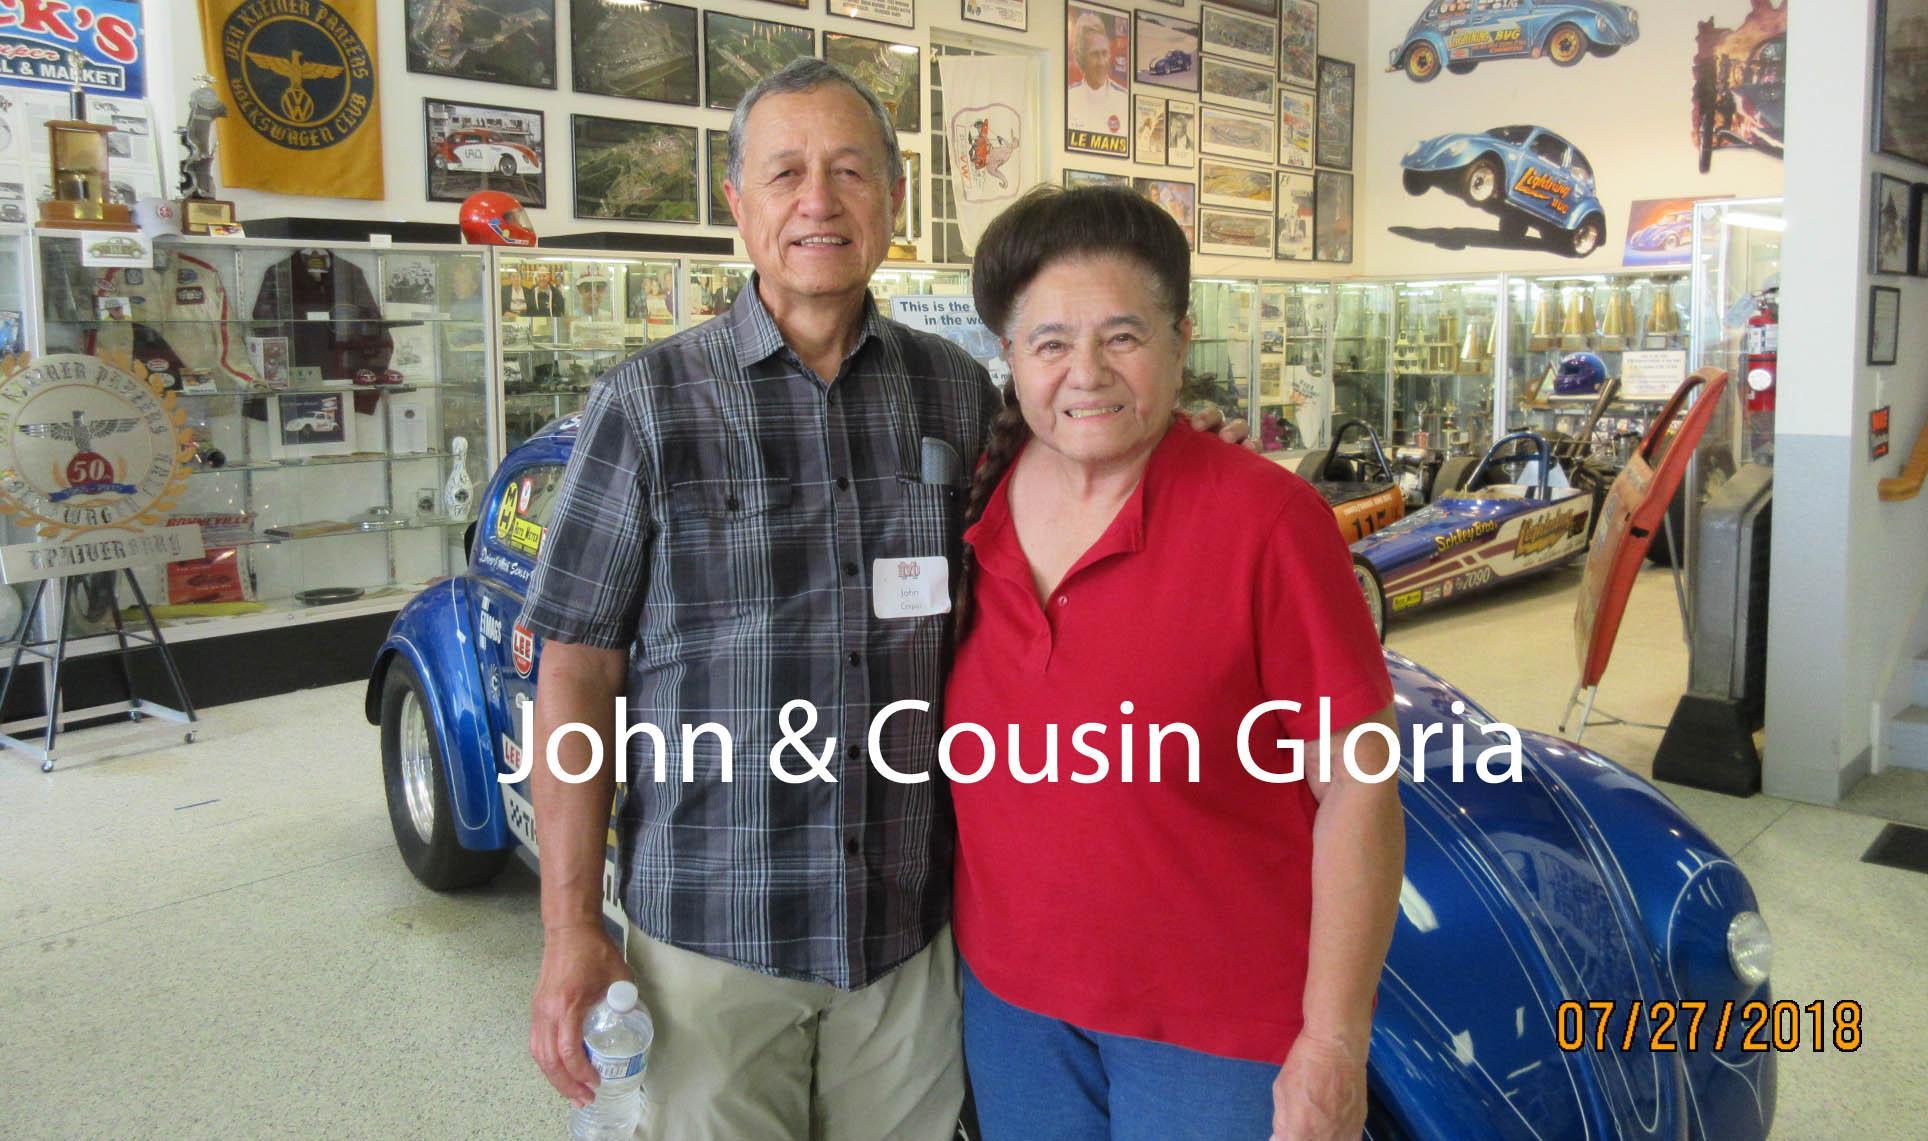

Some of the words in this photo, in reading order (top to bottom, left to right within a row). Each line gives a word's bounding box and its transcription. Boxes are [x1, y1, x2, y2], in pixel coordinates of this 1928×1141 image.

[21, 61, 34, 76] &
[1071, 132, 1086, 146] LE
[1090, 134, 1127, 152] MANS
[900, 301, 929, 312] This
[933, 301, 945, 312] is
[949, 301, 970, 312] the
[924, 315, 937, 326] in
[940, 315, 962, 325] the
[73, 459, 105, 483] 50
[514, 631, 531, 658] LEE
